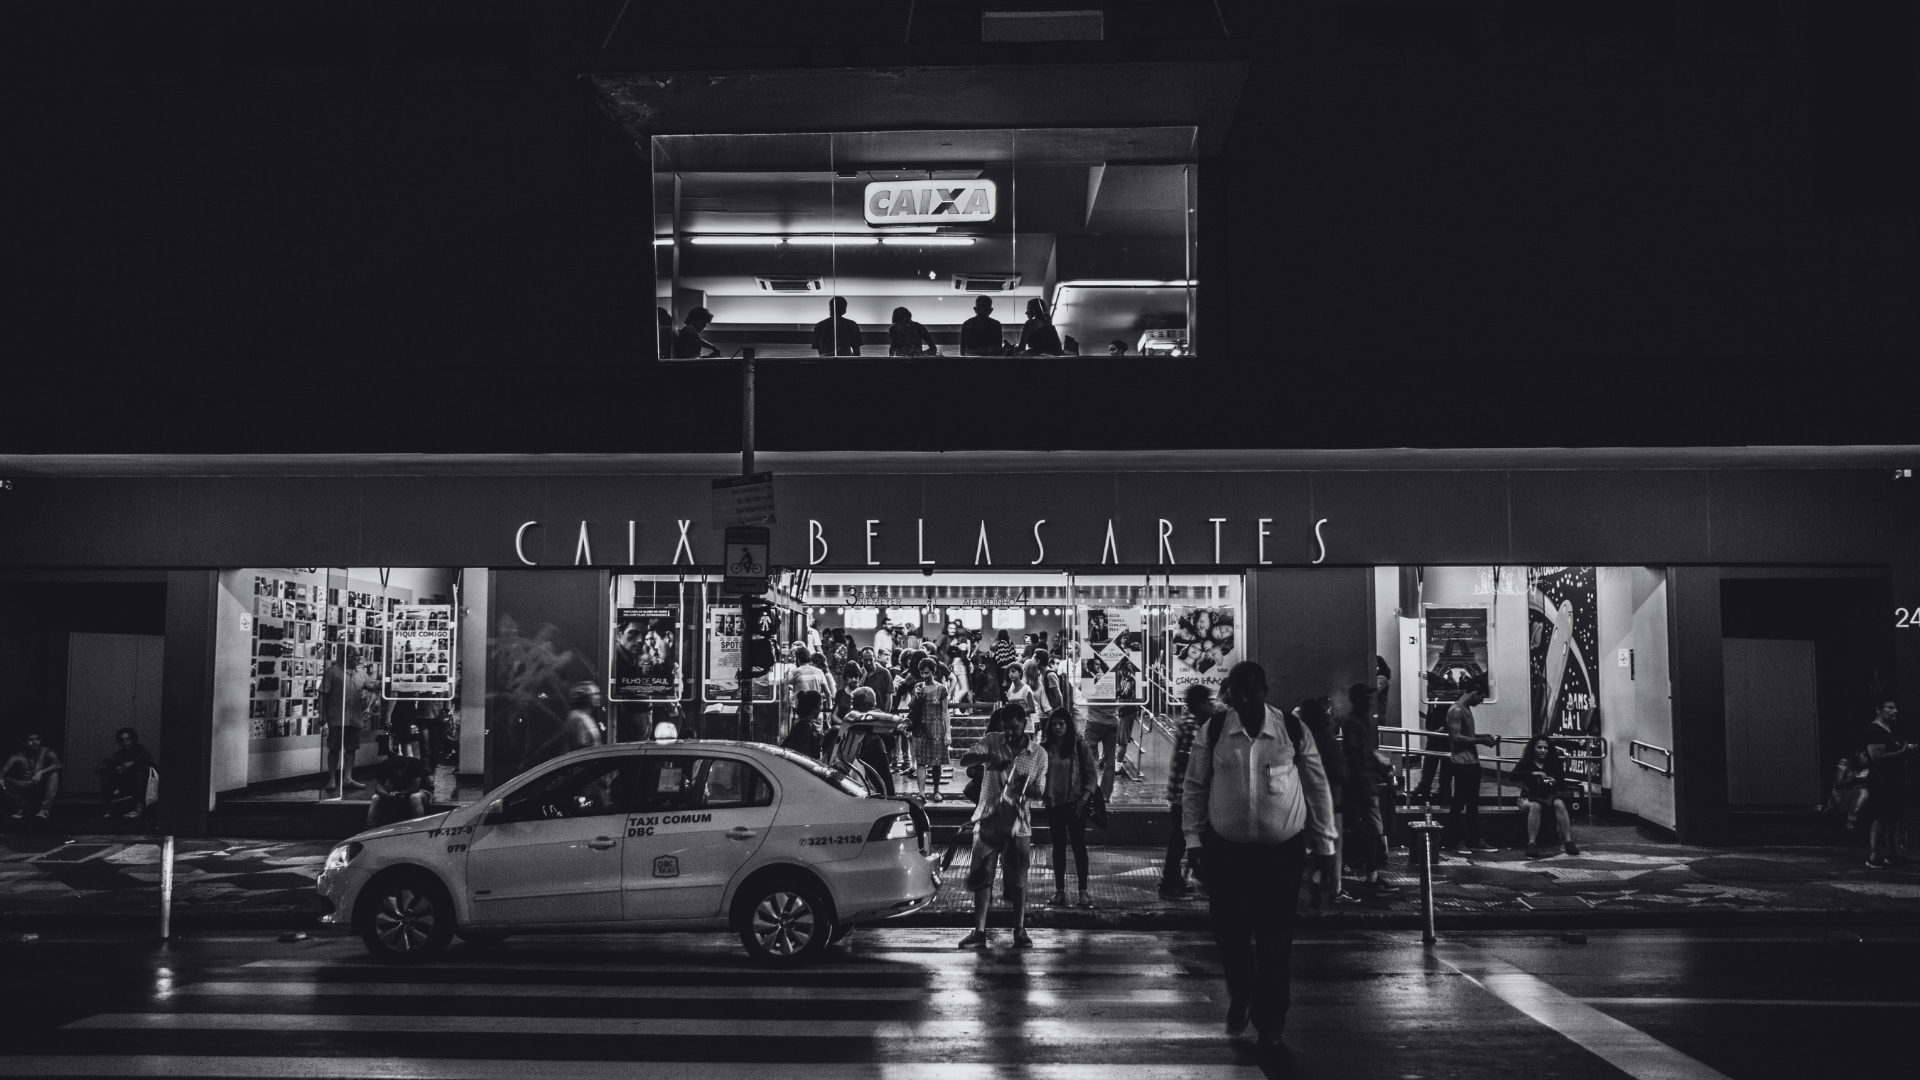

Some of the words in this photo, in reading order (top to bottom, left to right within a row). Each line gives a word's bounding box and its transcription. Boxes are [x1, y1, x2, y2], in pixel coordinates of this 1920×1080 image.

[869, 188, 990, 217] CAIXA
[515, 520, 695, 565] CAIX
[809, 519, 1046, 565] BELAS
[1101, 518, 1328, 564] ARTES
[846, 587, 857, 605] 3
[1016, 587, 1029, 606] 4
[1176, 676, 1199, 685] CINCO
[1201, 676, 1222, 686] GRAC
[1568, 693, 1588, 710] DANS
[1562, 710, 1573, 729] LA
[629, 816, 658, 826] TAXI
[663, 813, 711, 824] COMUM
[428, 825, 472, 838] TP-127-9
[628, 827, 654, 837] DBC
[808, 835, 862, 846] 3221-2126
[447, 844, 467, 853] 079
